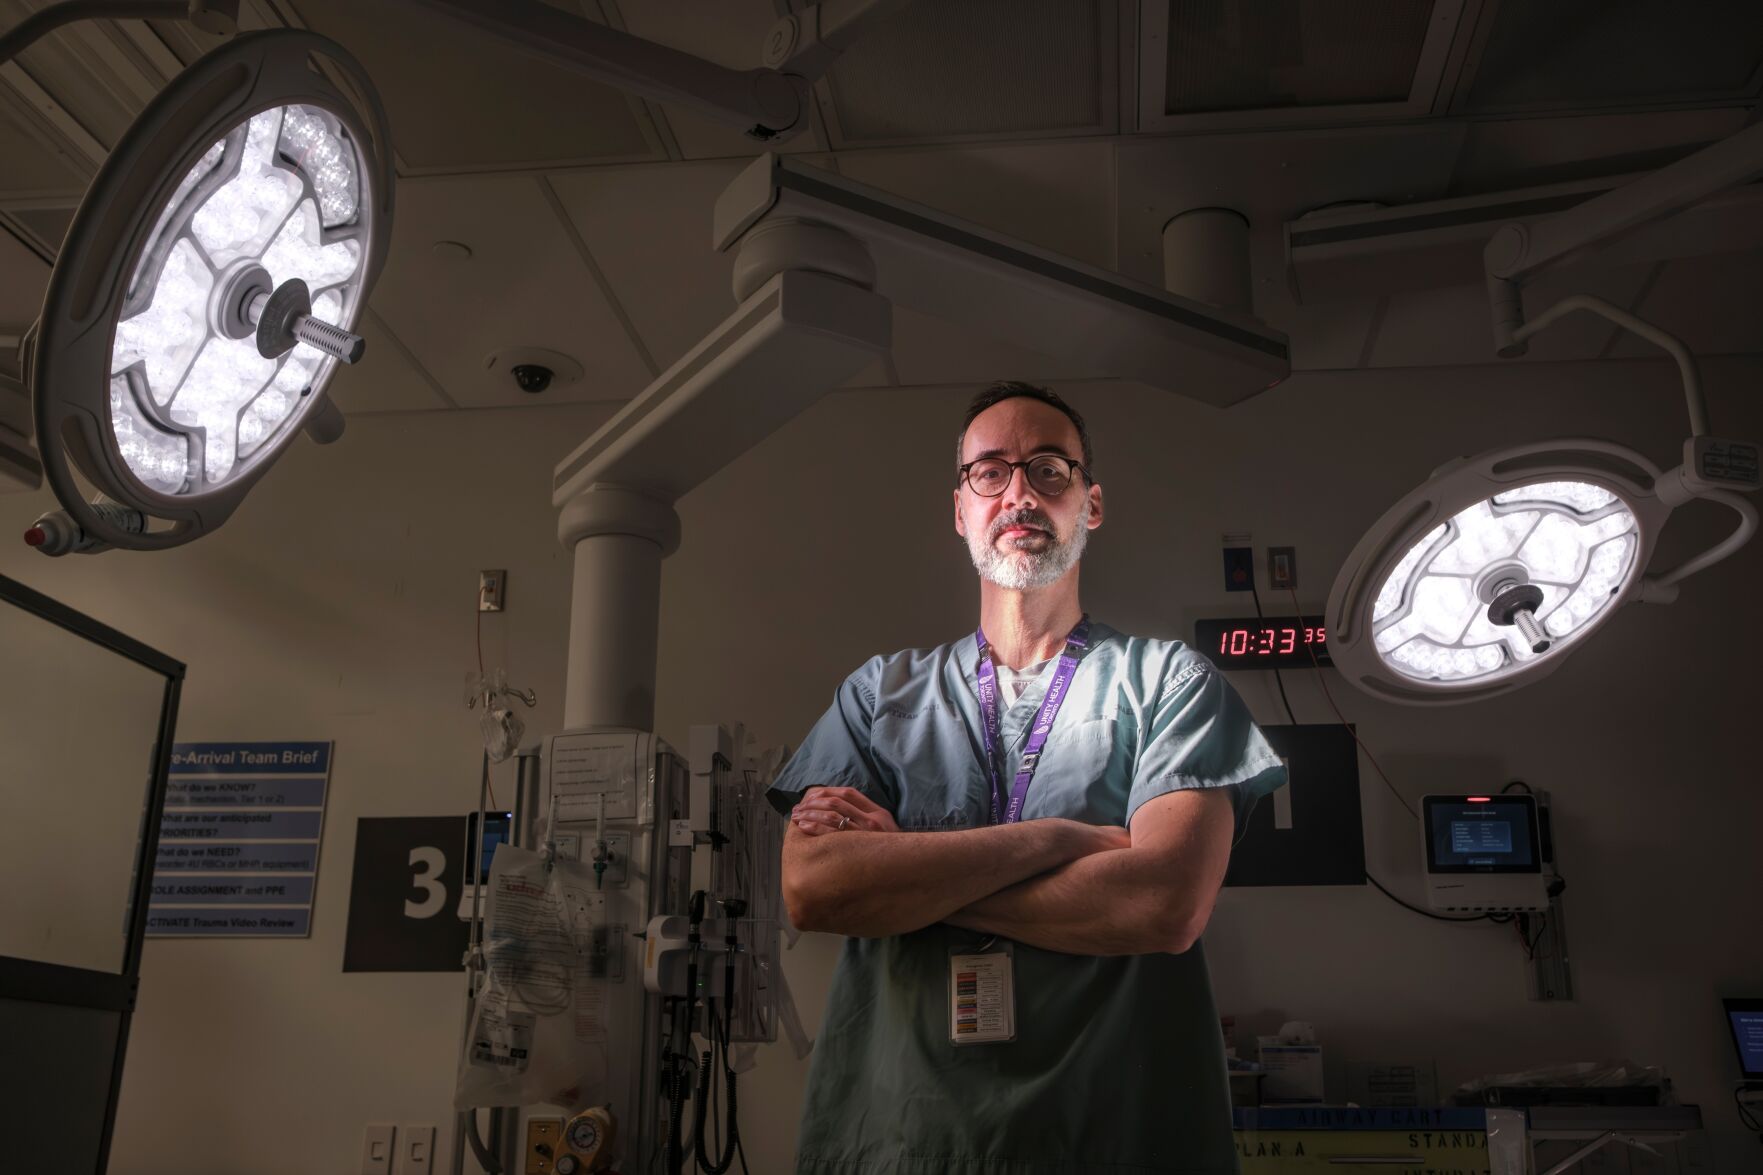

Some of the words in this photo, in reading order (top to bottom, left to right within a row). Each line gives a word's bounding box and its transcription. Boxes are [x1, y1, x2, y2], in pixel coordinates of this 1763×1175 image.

[1220, 628, 1296, 655] 10:33
[1304, 627, 1326, 643] 35
[984, 683, 994, 704] UNITY
[1040, 703, 1053, 725] UNITY
[1050, 675, 1066, 702] HEALTH
[987, 704, 996, 734] HEALTH
[170, 751, 235, 765] e-Arrival
[239, 751, 278, 764] Team
[282, 750, 319, 764] Brief
[167, 783, 187, 792] hat
[188, 783, 201, 792] do
[219, 783, 256, 792] KNOW?
[1006, 797, 1020, 824] EALTH
[220, 813, 272, 824] anticipated
[160, 829, 218, 838] RIORITIES?
[158, 848, 176, 856] hat
[177, 848, 189, 857] do
[207, 848, 240, 857] NEED?
[404, 846, 448, 919] 3
[177, 886, 243, 895] ASSIGNMENT
[265, 886, 286, 895] PPE
[193, 918, 228, 927] Trauma
[230, 918, 257, 927] Video
[260, 918, 295, 927] Review
[1298, 1109, 1377, 1124] AIRWAY
[1391, 1109, 1442, 1124] CART
[1295, 1141, 1305, 1156] A
